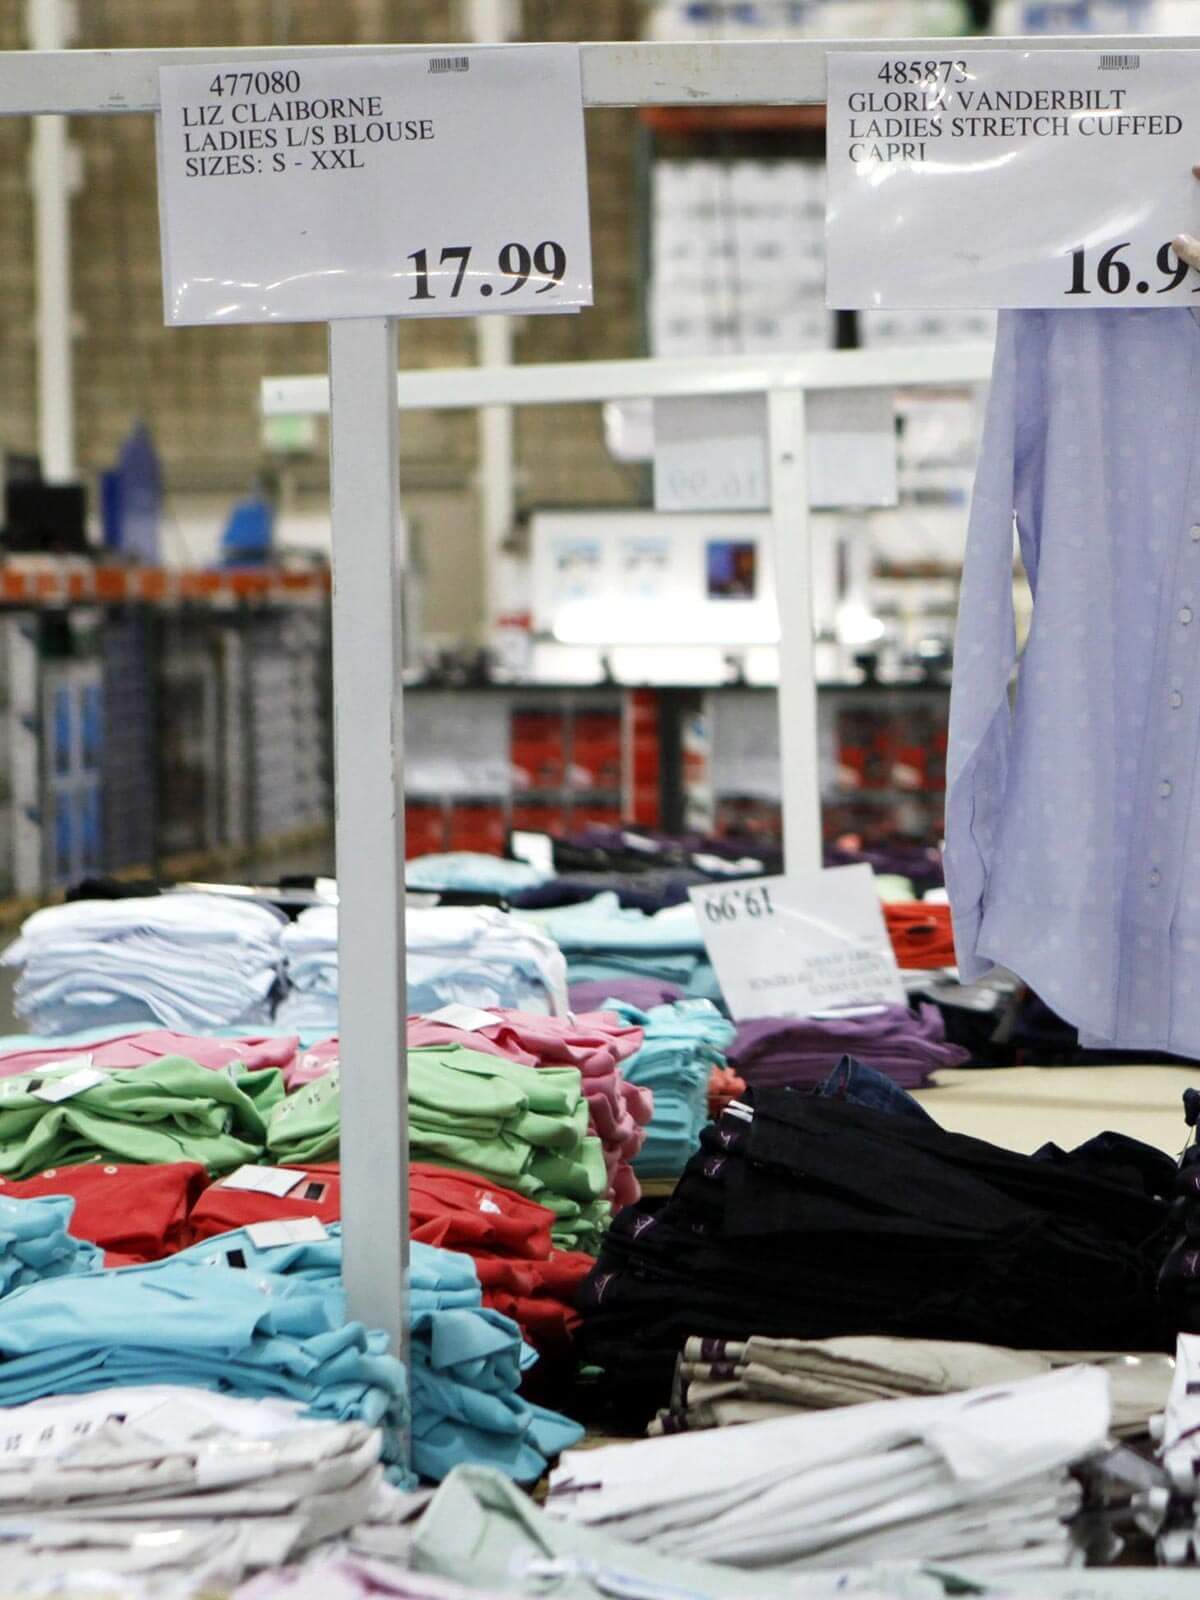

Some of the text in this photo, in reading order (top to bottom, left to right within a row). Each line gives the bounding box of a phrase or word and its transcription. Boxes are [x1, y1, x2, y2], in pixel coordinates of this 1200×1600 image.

[210, 71, 300, 96] 477080
[877, 61, 968, 84] 485873
[182, 97, 383, 126] LIZ CLAIBORNE
[956, 90, 1126, 110] VANDERBILT
[184, 120, 435, 152] LADIES L/S BLOUSE
[849, 116, 1183, 138] LADIES STRETCH CUFFED
[185, 155, 263, 177] SIZES:
[273, 152, 286, 172] S
[311, 149, 365, 170] XXL
[848, 143, 926, 162] CAPRI
[407, 241, 567, 300] 17.99
[704, 886, 775, 922] 19.99
